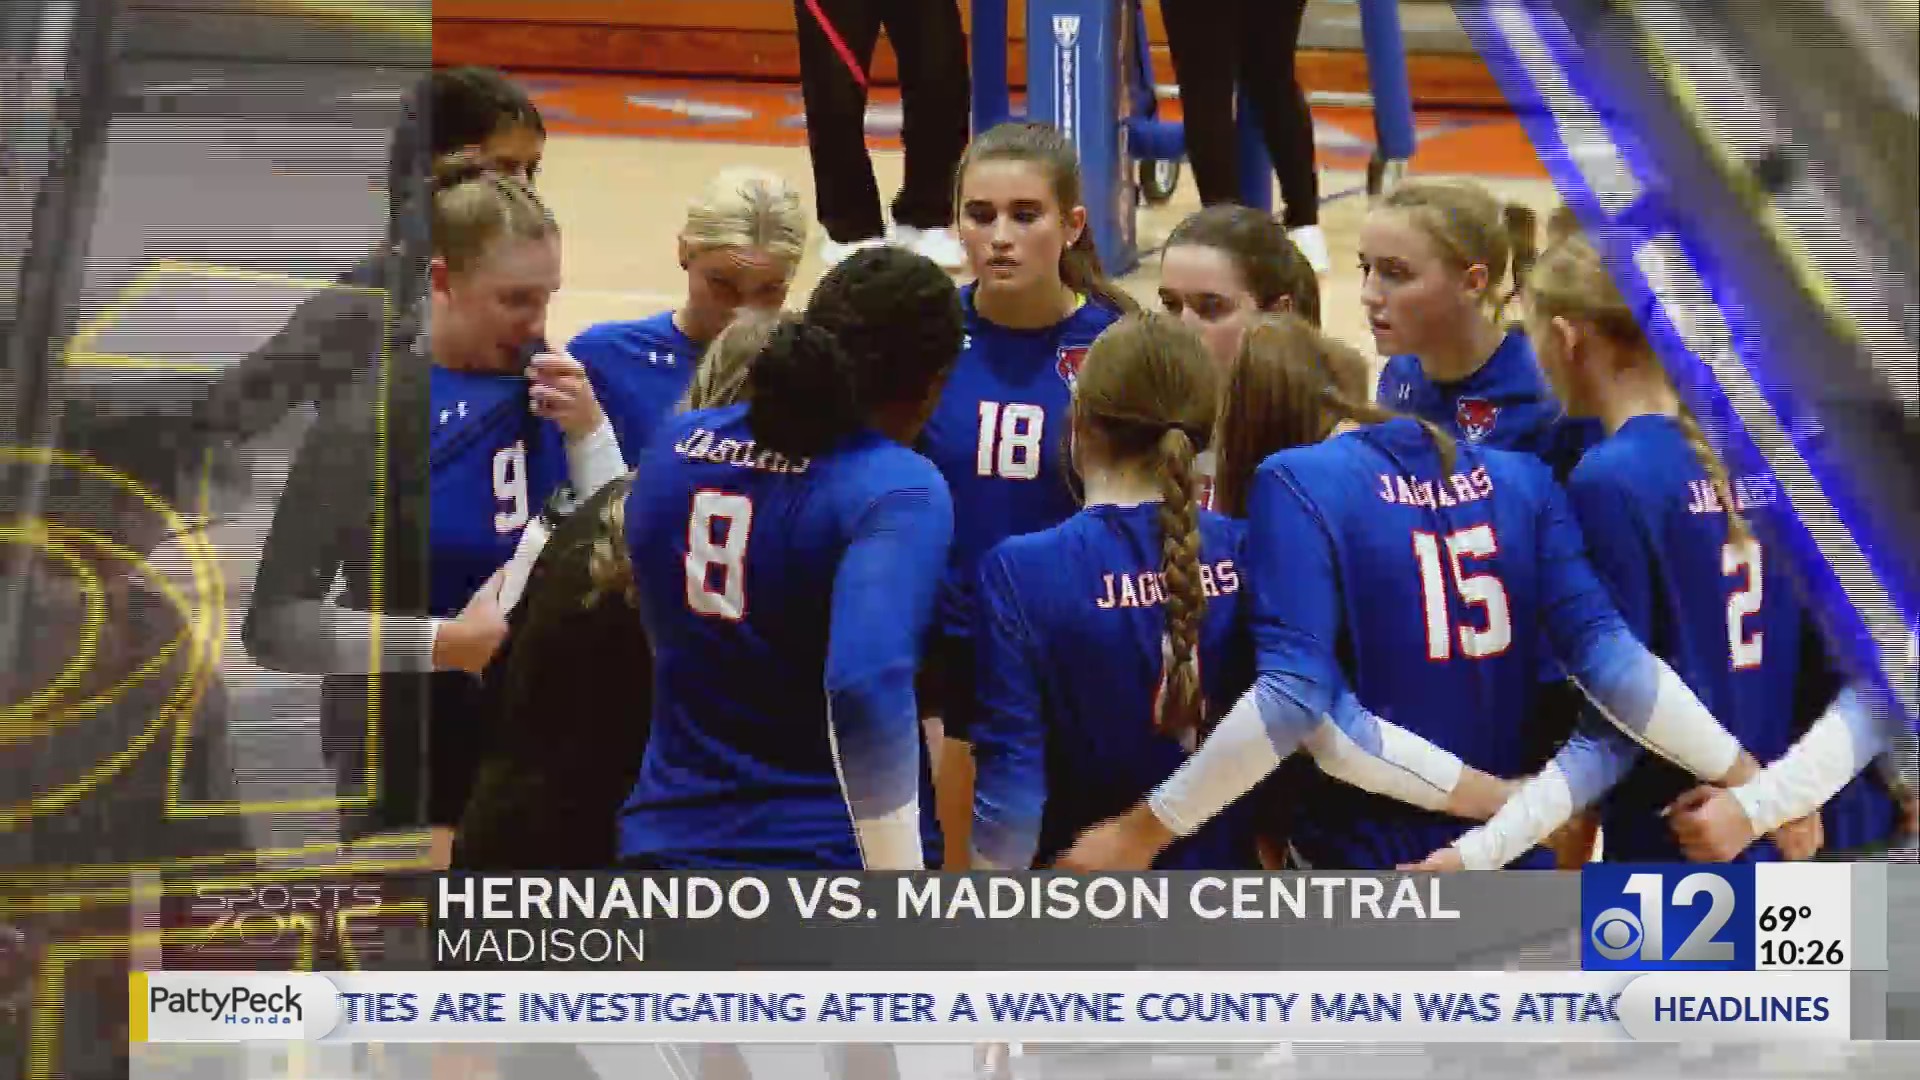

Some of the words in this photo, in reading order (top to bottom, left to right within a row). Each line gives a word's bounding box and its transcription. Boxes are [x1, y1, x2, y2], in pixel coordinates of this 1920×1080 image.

[492, 441, 529, 534] 9
[977, 400, 1045, 479] 18
[684, 487, 753, 621] 8
[1095, 559, 1240, 610] JAGURS
[1413, 524, 1512, 661] 15
[1721, 539, 1764, 670] 2
